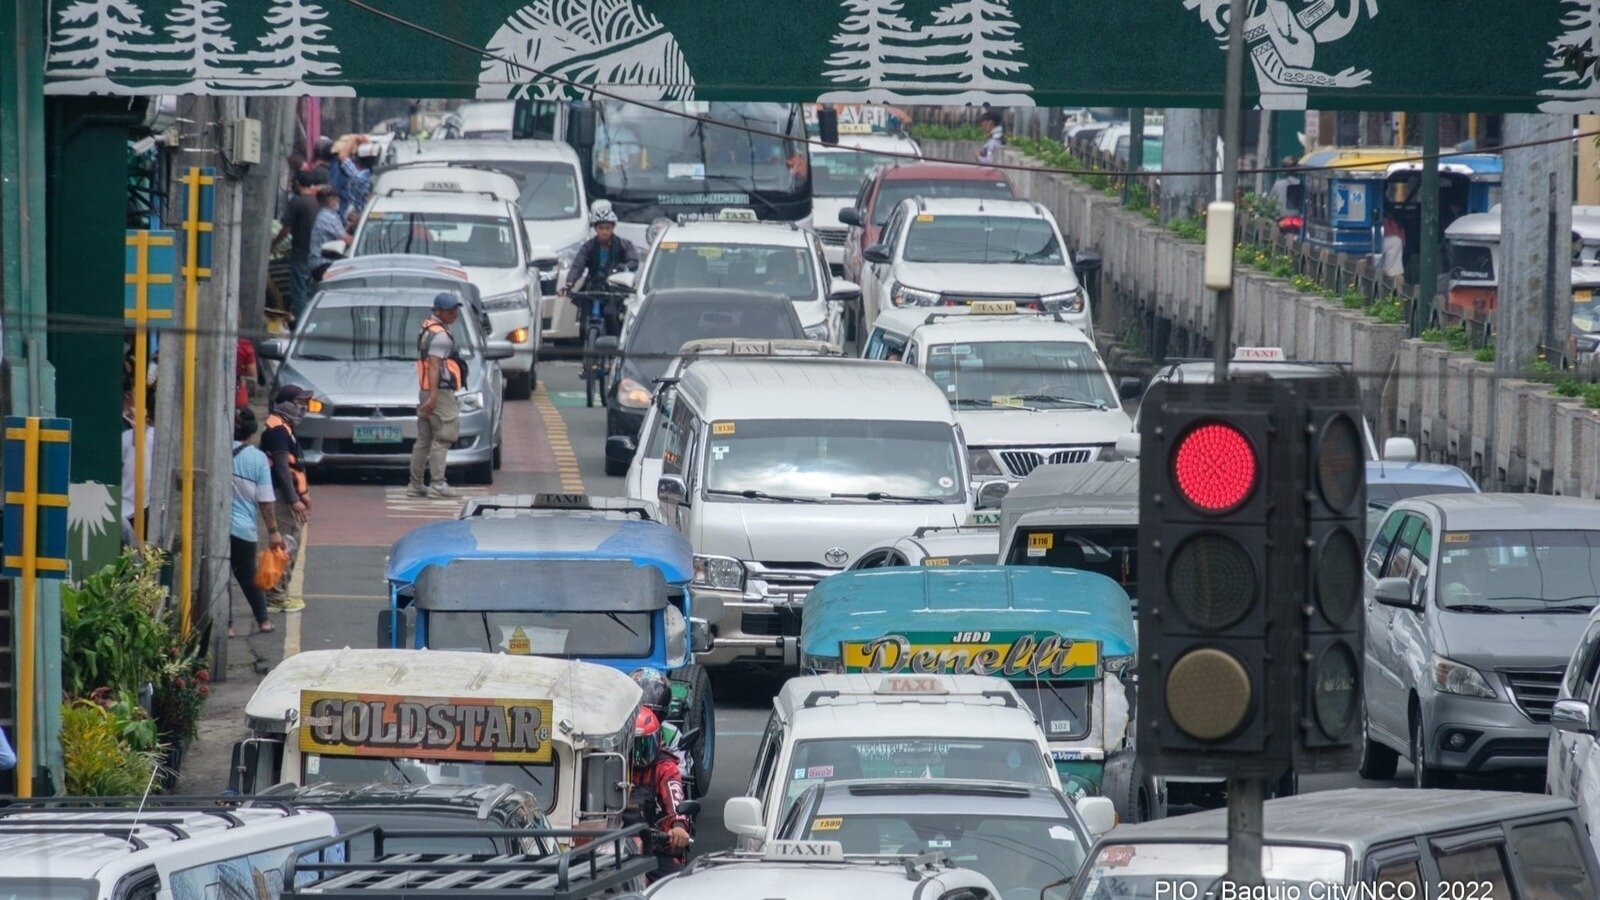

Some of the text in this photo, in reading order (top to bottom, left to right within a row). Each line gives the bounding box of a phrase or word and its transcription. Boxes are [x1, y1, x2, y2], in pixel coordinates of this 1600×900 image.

[724, 211, 751, 219] TAXI
[545, 494, 581, 503] TAXI
[973, 514, 1000, 524] TAX
[861, 634, 1077, 676] Denelli
[888, 678, 937, 691] TAXI
[311, 699, 541, 752] GOLDSTAR
[781, 844, 827, 855] TAXI
